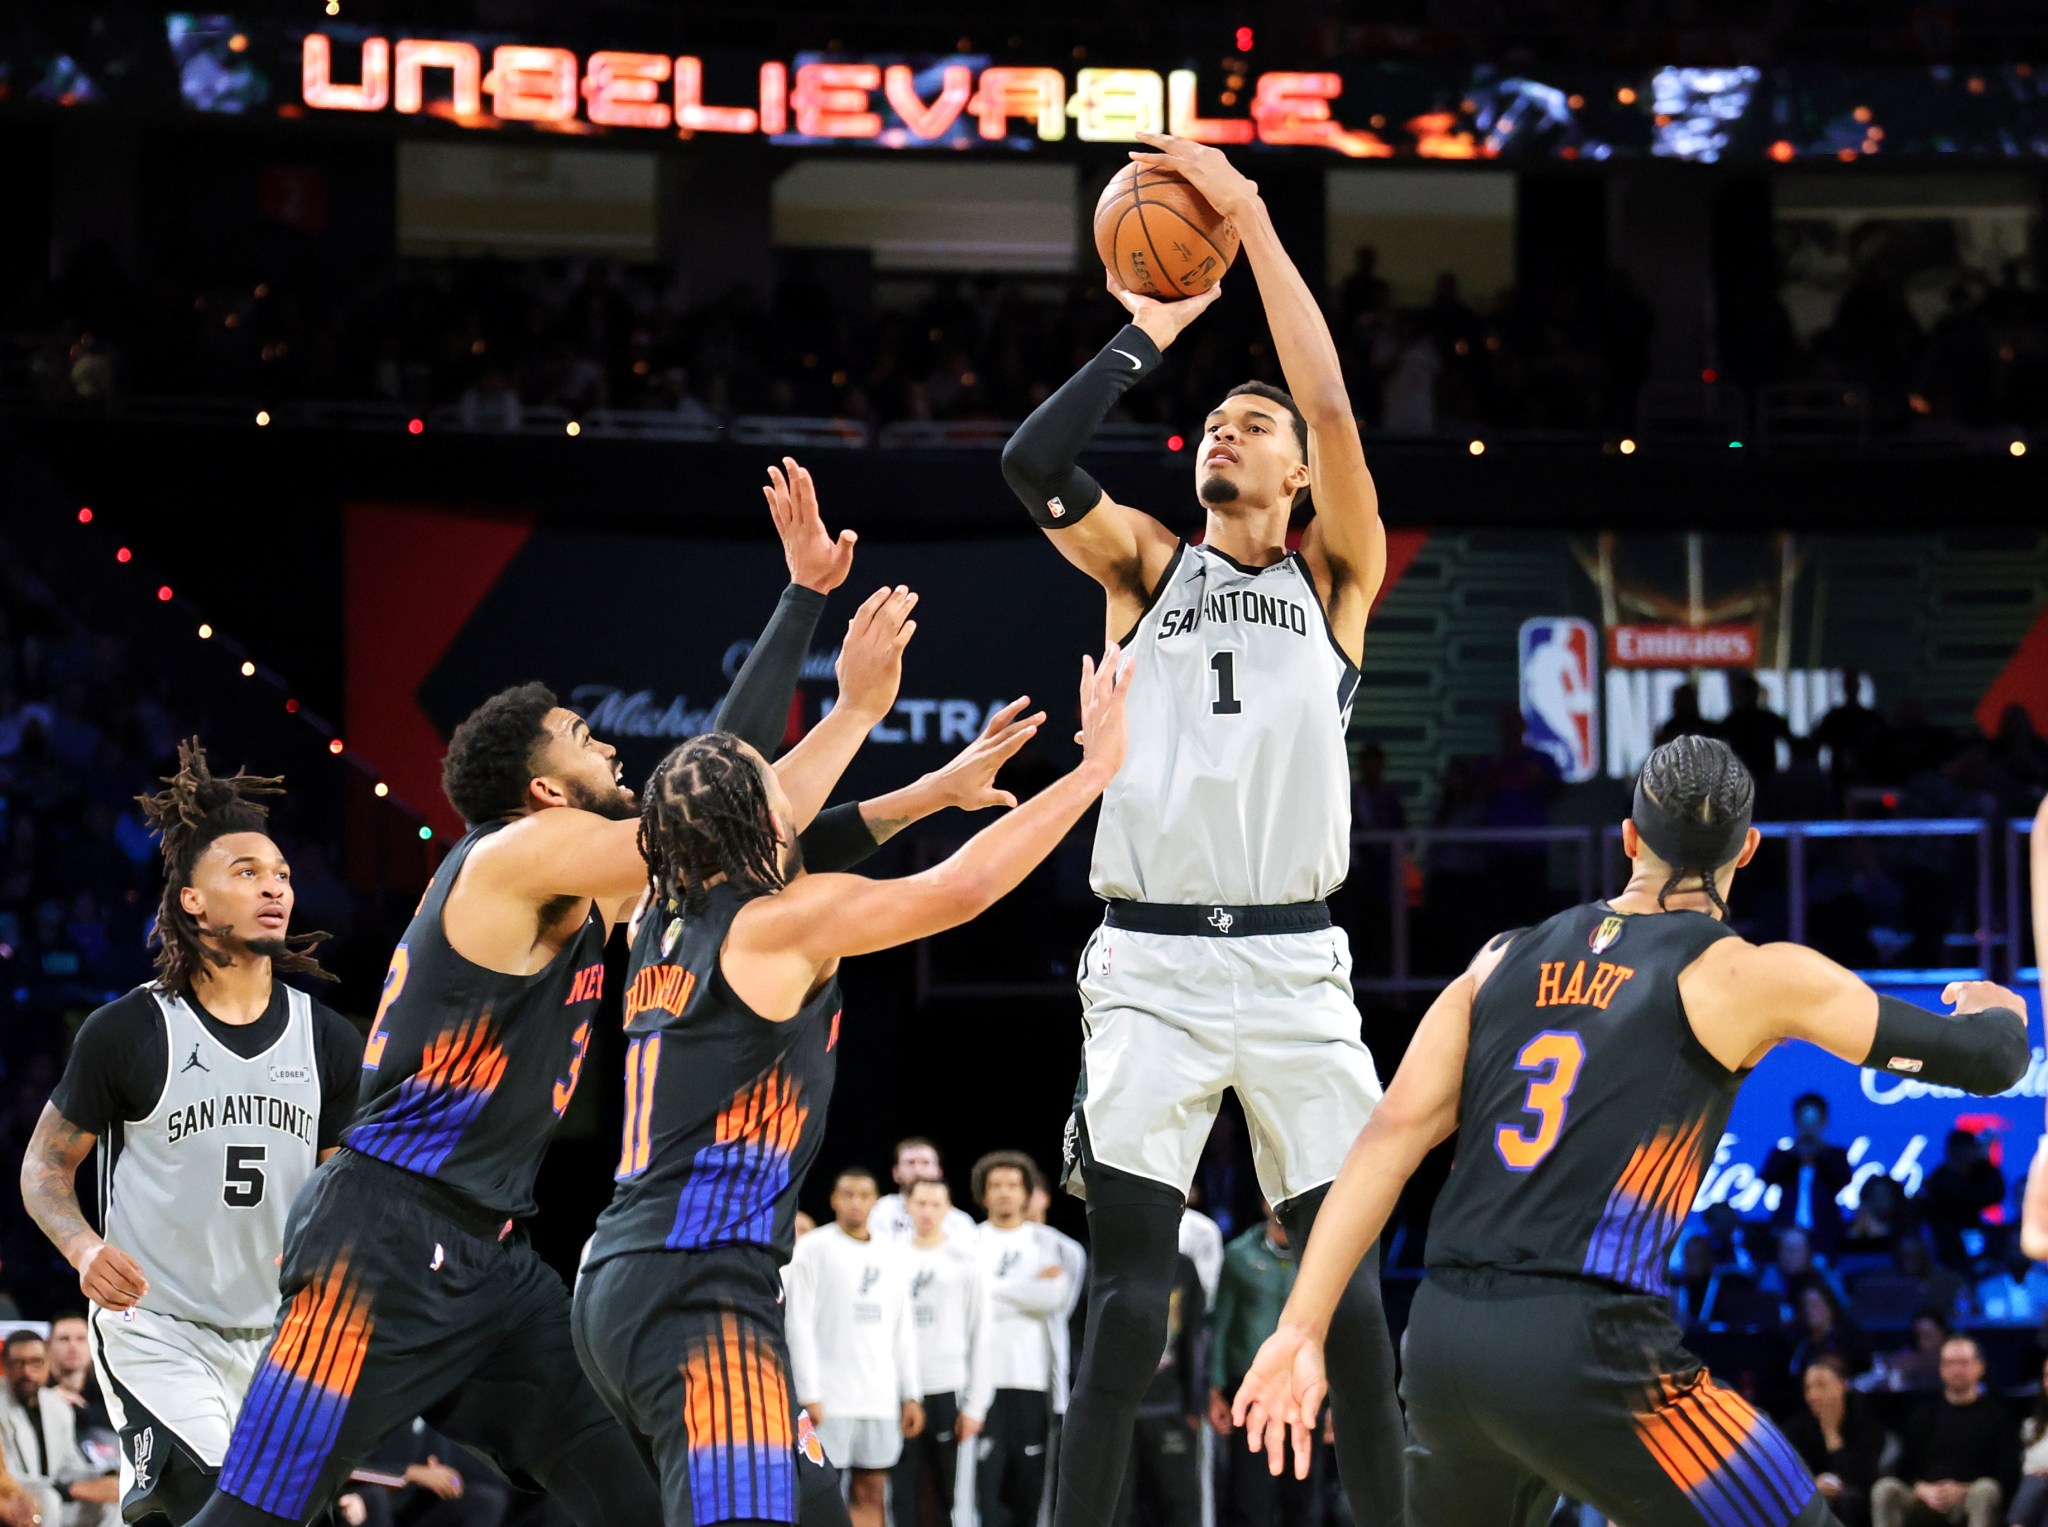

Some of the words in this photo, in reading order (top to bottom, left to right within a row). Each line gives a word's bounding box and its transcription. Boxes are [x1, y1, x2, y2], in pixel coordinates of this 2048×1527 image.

[1615, 630, 1752, 660] Emirates
[1210, 649, 1242, 715] 1
[1535, 960, 1635, 1010] HART
[274, 1070, 304, 1079] LEDGER
[1493, 1029, 1587, 1172] 3
[168, 1098, 215, 1144] SAN
[221, 1093, 314, 1146] ANTONIO
[613, 1031, 661, 1180] 11
[222, 1144, 268, 1209] 5
